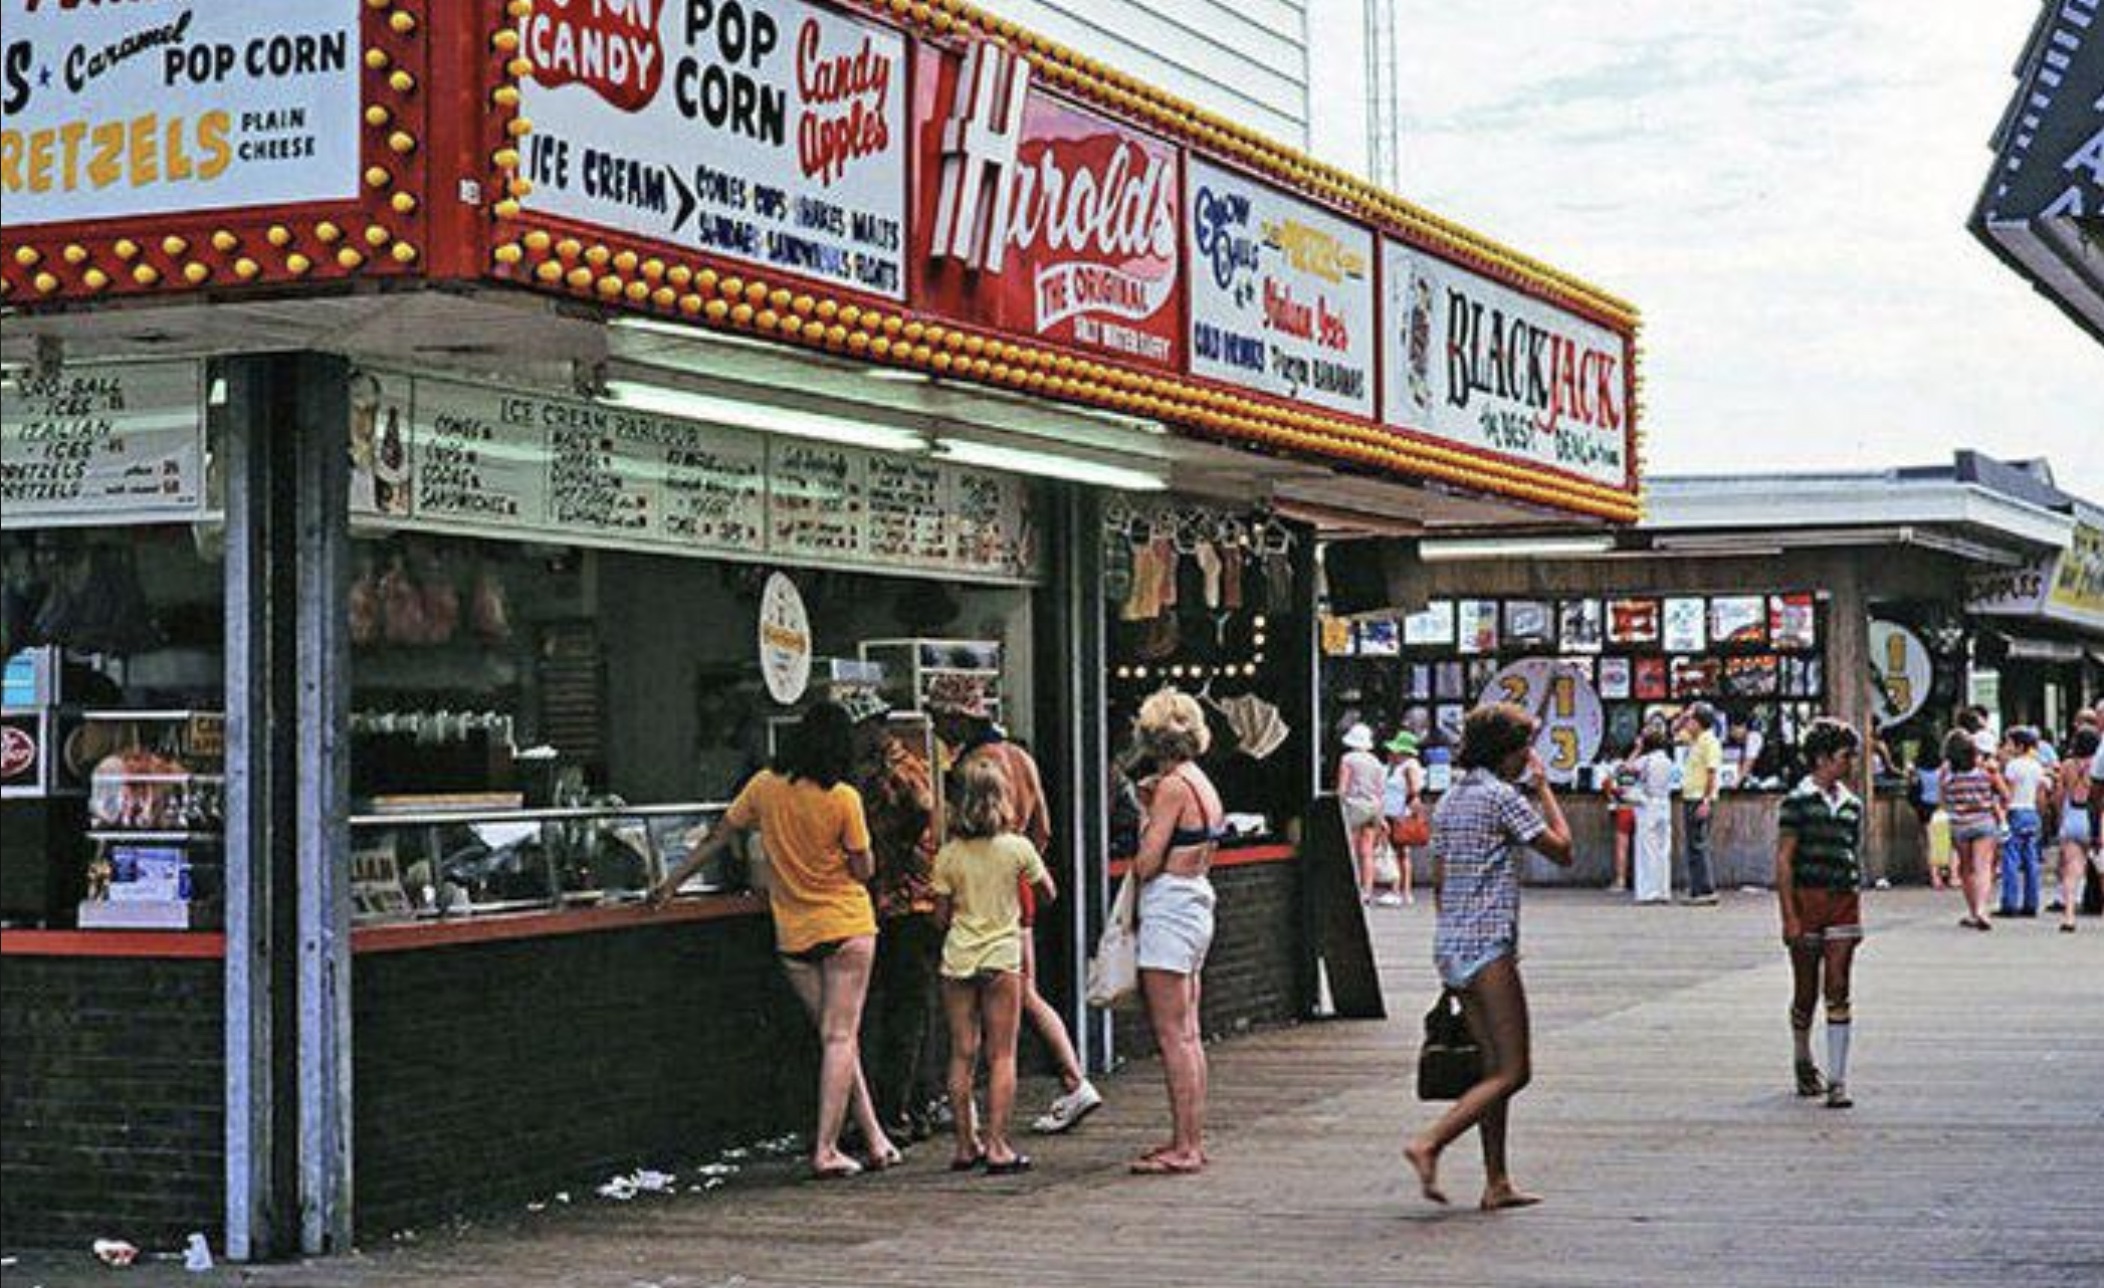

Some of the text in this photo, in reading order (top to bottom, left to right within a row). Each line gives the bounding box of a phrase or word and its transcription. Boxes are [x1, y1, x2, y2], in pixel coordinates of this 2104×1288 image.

[65, 10, 192, 93] Caramel
[165, 45, 236, 86] POP
[245, 30, 346, 77] CORN
[531, 12, 655, 91] CANDY
[686, 0, 777, 68] POP
[796, 17, 892, 108] Candy
[241, 108, 305, 132] PLAIN
[675, 56, 786, 147] CORN
[238, 136, 315, 161] CHEESE
[530, 135, 668, 214] ICE CREAM
[696, 164, 747, 211] CONES
[754, 182, 787, 222] CUPS
[850, 211, 900, 253] MALTS
[1042, 270, 1068, 318] THE
[43, 440, 93, 460] ICES
[501, 398, 533, 424] ICE
[543, 402, 608, 429] CREAM
